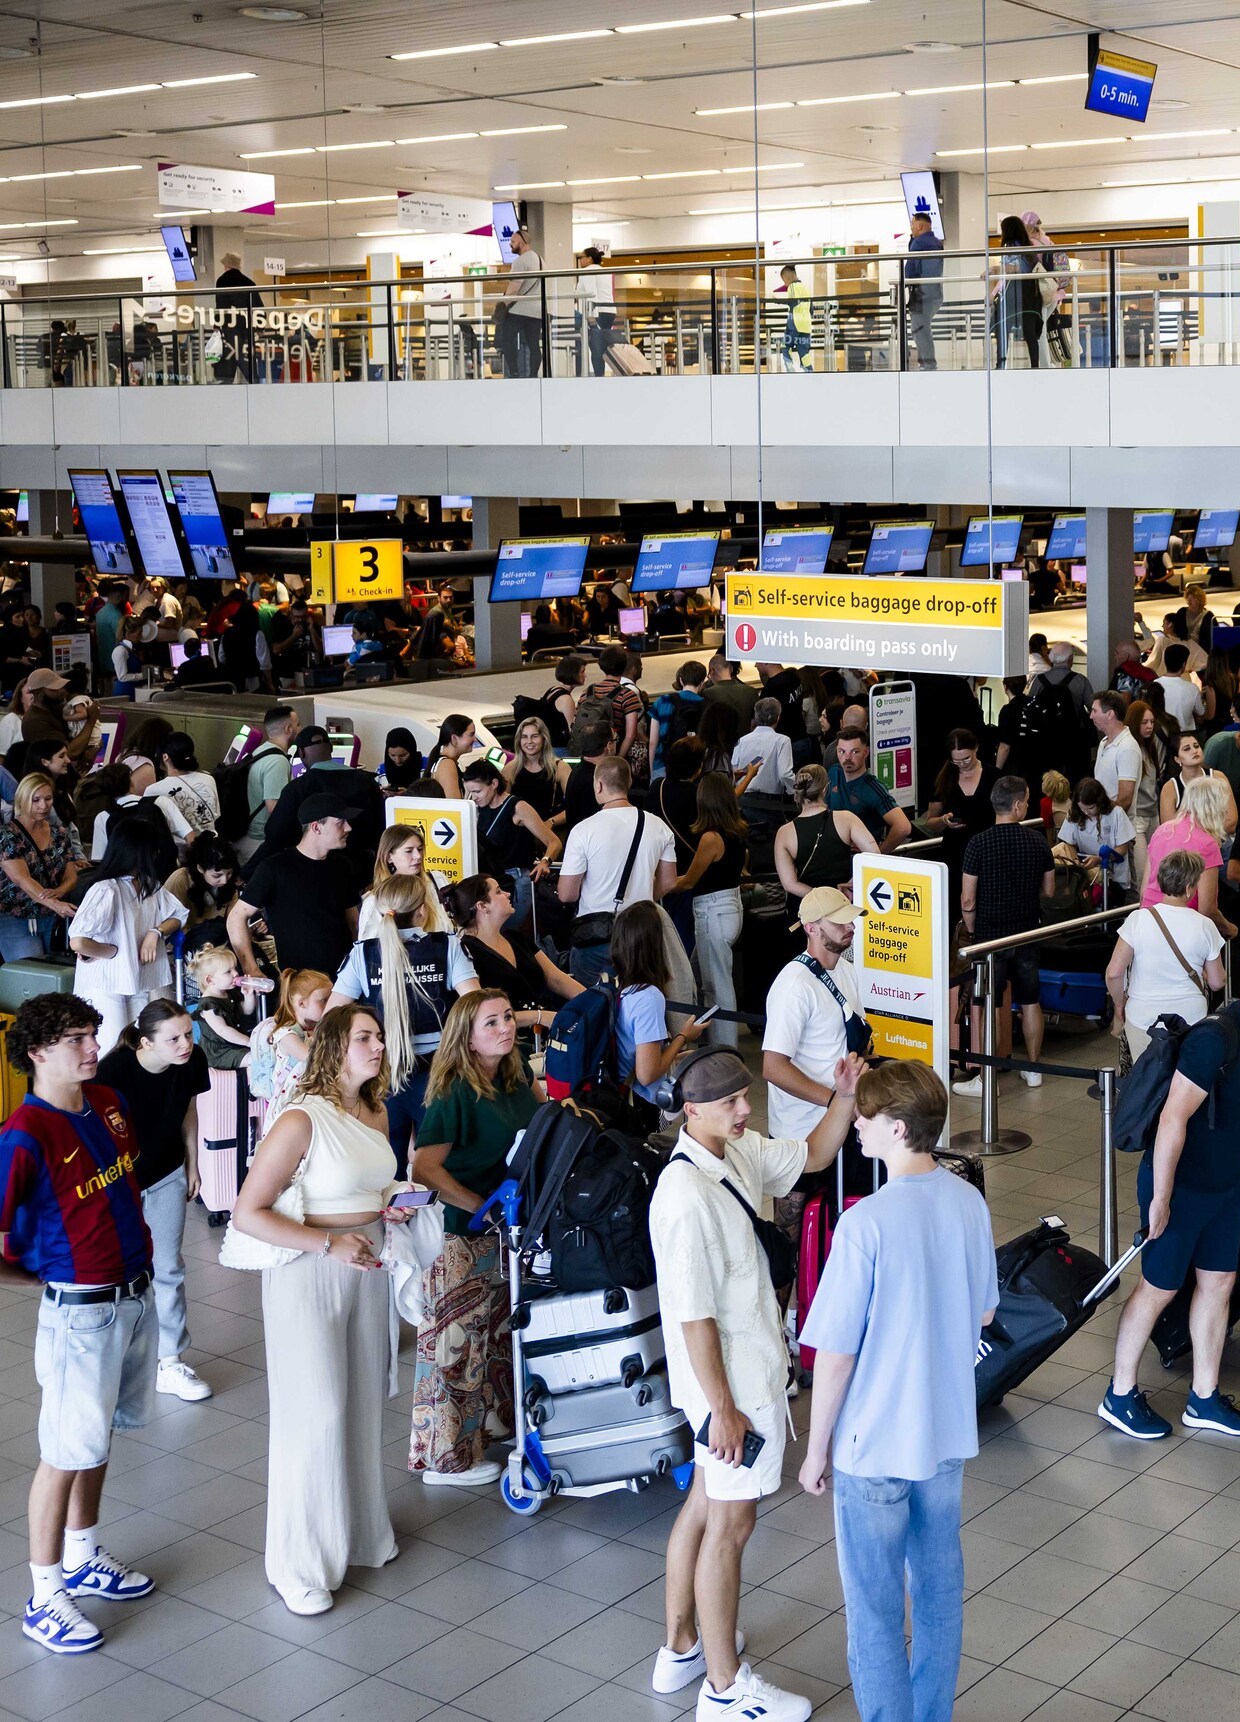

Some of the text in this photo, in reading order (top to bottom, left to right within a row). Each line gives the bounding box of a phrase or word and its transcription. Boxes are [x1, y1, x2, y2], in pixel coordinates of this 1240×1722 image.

[1100, 84, 1139, 107] 0-5 min.
[173, 173, 187, 181] ready
[266, 262, 284, 271] 14-15
[0, 279, 15, 287] 2-13
[713, 531, 717, 539] 2
[317, 547, 322, 558] 3
[359, 546, 379, 582] 3
[641, 562, 672, 571] Self-service
[501, 570, 536, 579] Self-service
[640, 569, 663, 578] drop-off
[500, 577, 526, 587] drop-off
[359, 587, 393, 596] Check-in
[758, 588, 997, 616] Self-service baggage drop-off
[762, 630, 958, 662] With boarding pass only
[884, 696, 911, 705] transavia
[876, 710, 899, 718] Controleer
[425, 856, 458, 865] -service
[868, 920, 920, 937] Self-service
[868, 934, 908, 951] baggage
[868, 948, 907, 963] drop-off
[378, 964, 436, 976] KLIJKE
[371, 974, 444, 986] MAAUSSEE
[870, 982, 911, 1001] Austrian
[885, 1032, 928, 1050] Lufthansa
[76, 1156, 123, 1199] unicef
